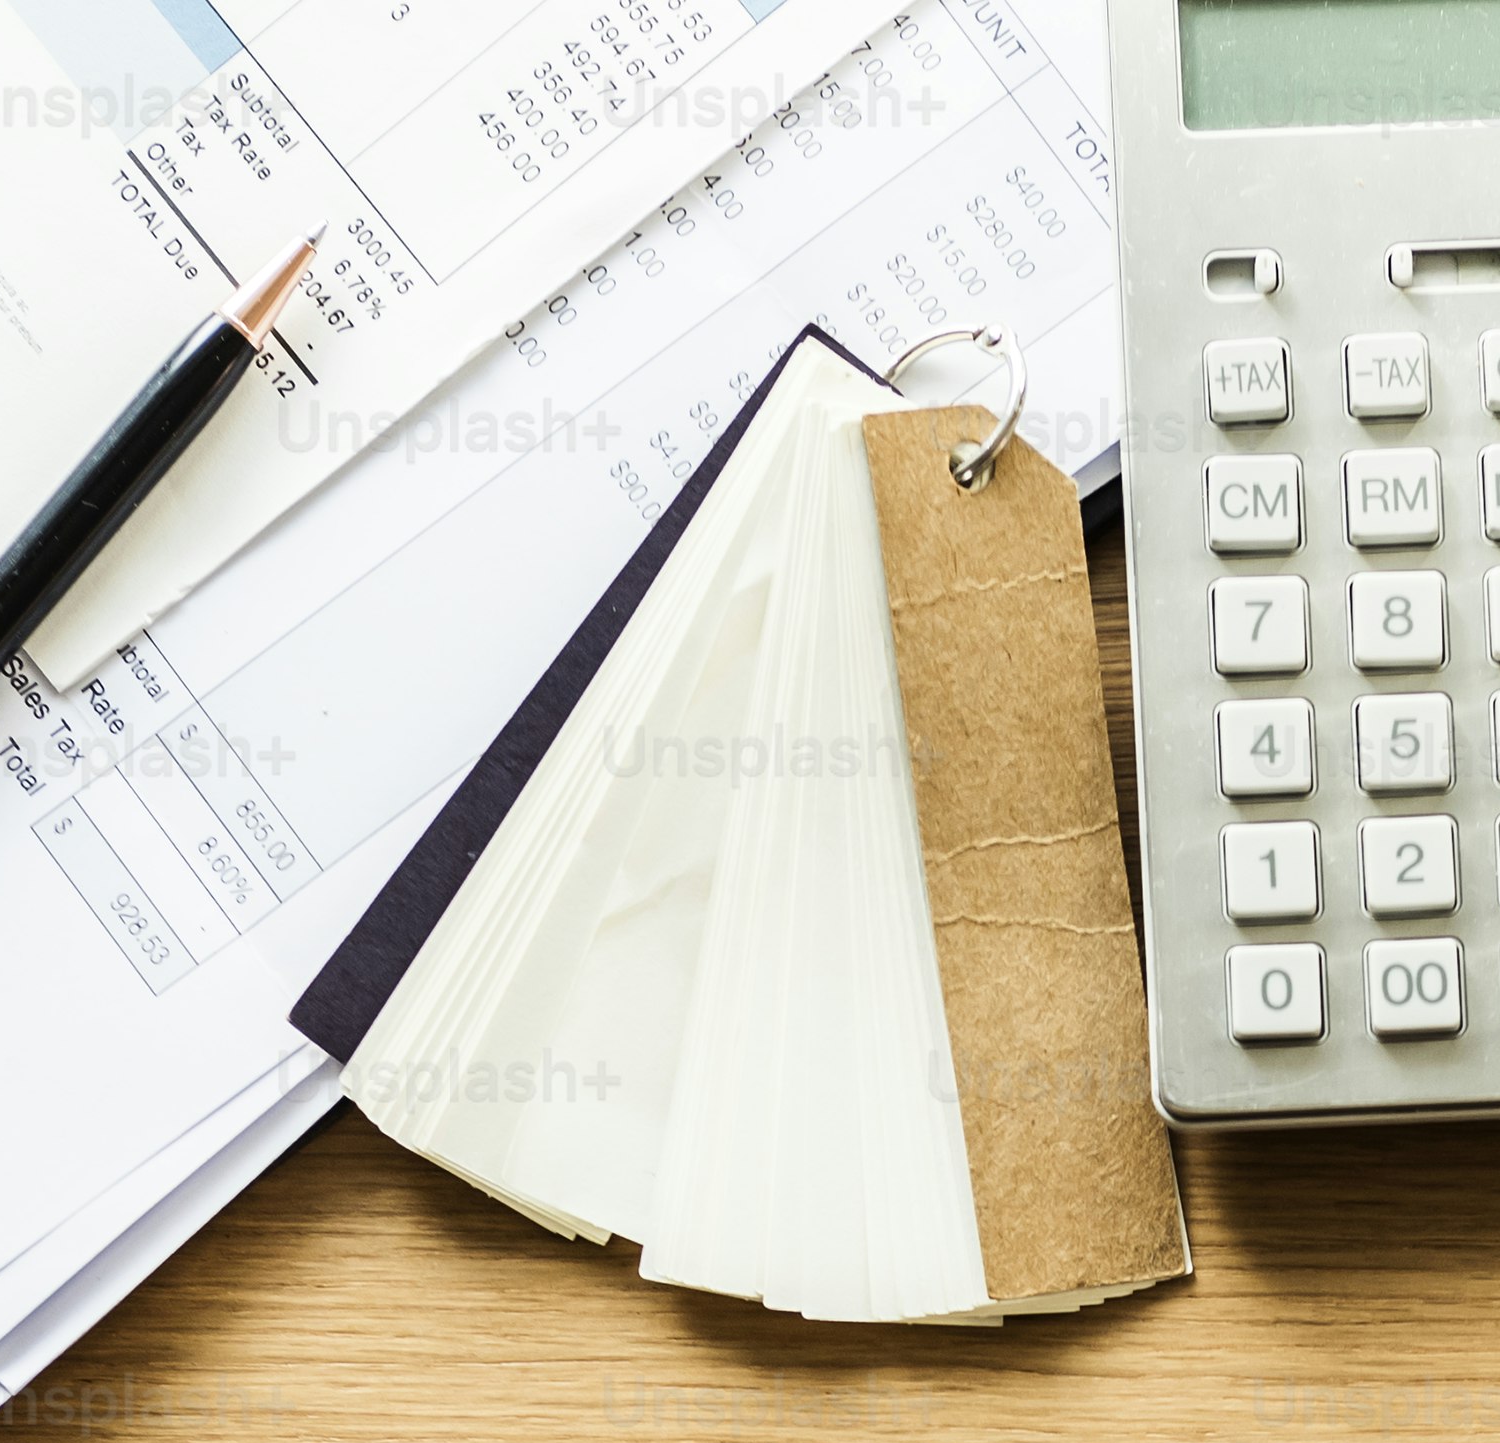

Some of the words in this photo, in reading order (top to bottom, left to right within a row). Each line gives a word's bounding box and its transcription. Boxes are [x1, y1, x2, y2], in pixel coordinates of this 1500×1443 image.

[563, 39, 628, 112] 492.74
[589, 14, 657, 85] 594.67
[892, 13, 942, 72] 40.00
[230, 73, 300, 153] Subtotal
[507, 88, 570, 160] 400.00
[532, 61, 599, 136] 356.40
[812, 71, 863, 130] 15.00
[146, 142, 195, 197] Other
[175, 117, 206, 157] Tax
[203, 94, 234, 134] Tax
[231, 132, 272, 182] Rate
[477, 111, 541, 183] 456.00
[1065, 120, 1111, 195] TOTA
[110, 169, 167, 239] TOTAL
[162, 237, 198, 281] Due
[965, 194, 1036, 281] $280.00
[1005, 165, 1067, 239] $40.00
[334, 259, 387, 321] 6.78%
[347, 218, 414, 296] 3000.45
[625, 231, 665, 278] 1.00
[887, 253, 947, 326] $20.00
[926, 223, 987, 297] $15.00
[1215, 360, 1281, 394] +TAX
[1220, 483, 1288, 519] CM
[1361, 477, 1429, 513] RM
[1244, 600, 1273, 642] 7
[1382, 595, 1414, 638] 8
[0, 655, 49, 720] Sales
[49, 718, 86, 766] Tax
[81, 678, 125, 735] Rate
[1249, 724, 1281, 764] 4
[1389, 718, 1421, 760] 5
[197, 837, 254, 905] 8.60%
[236, 799, 295, 872] 855.00
[1258, 849, 1278, 889] 1
[1394, 843, 1425, 884] 2
[110, 893, 170, 966] 928.53
[1261, 969, 1293, 1011] 0
[1381, 961, 1448, 1006] 00
